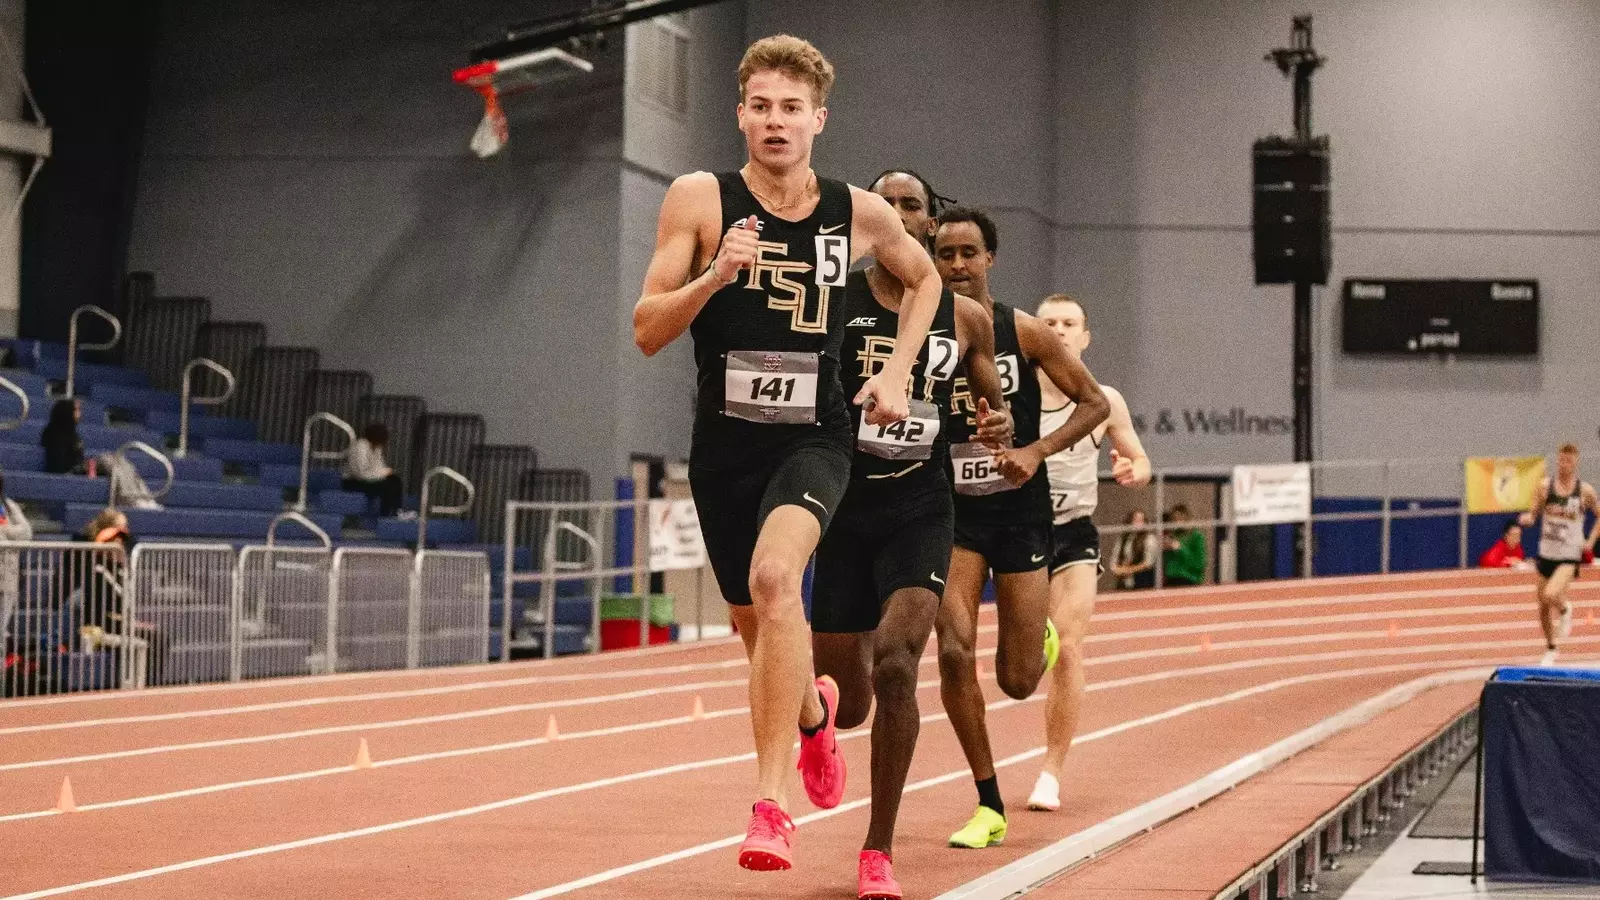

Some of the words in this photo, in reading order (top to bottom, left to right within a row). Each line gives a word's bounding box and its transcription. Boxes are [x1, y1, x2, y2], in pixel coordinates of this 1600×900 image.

[731, 217, 765, 231] AC
[823, 239, 841, 283] 5
[743, 241, 831, 334] FSU
[846, 317, 878, 327] ACC
[930, 340, 952, 379] 2
[750, 377, 796, 402] 141
[996, 359, 1013, 393] 3
[877, 420, 925, 442] 142
[1182, 407, 1293, 434] Wellnes
